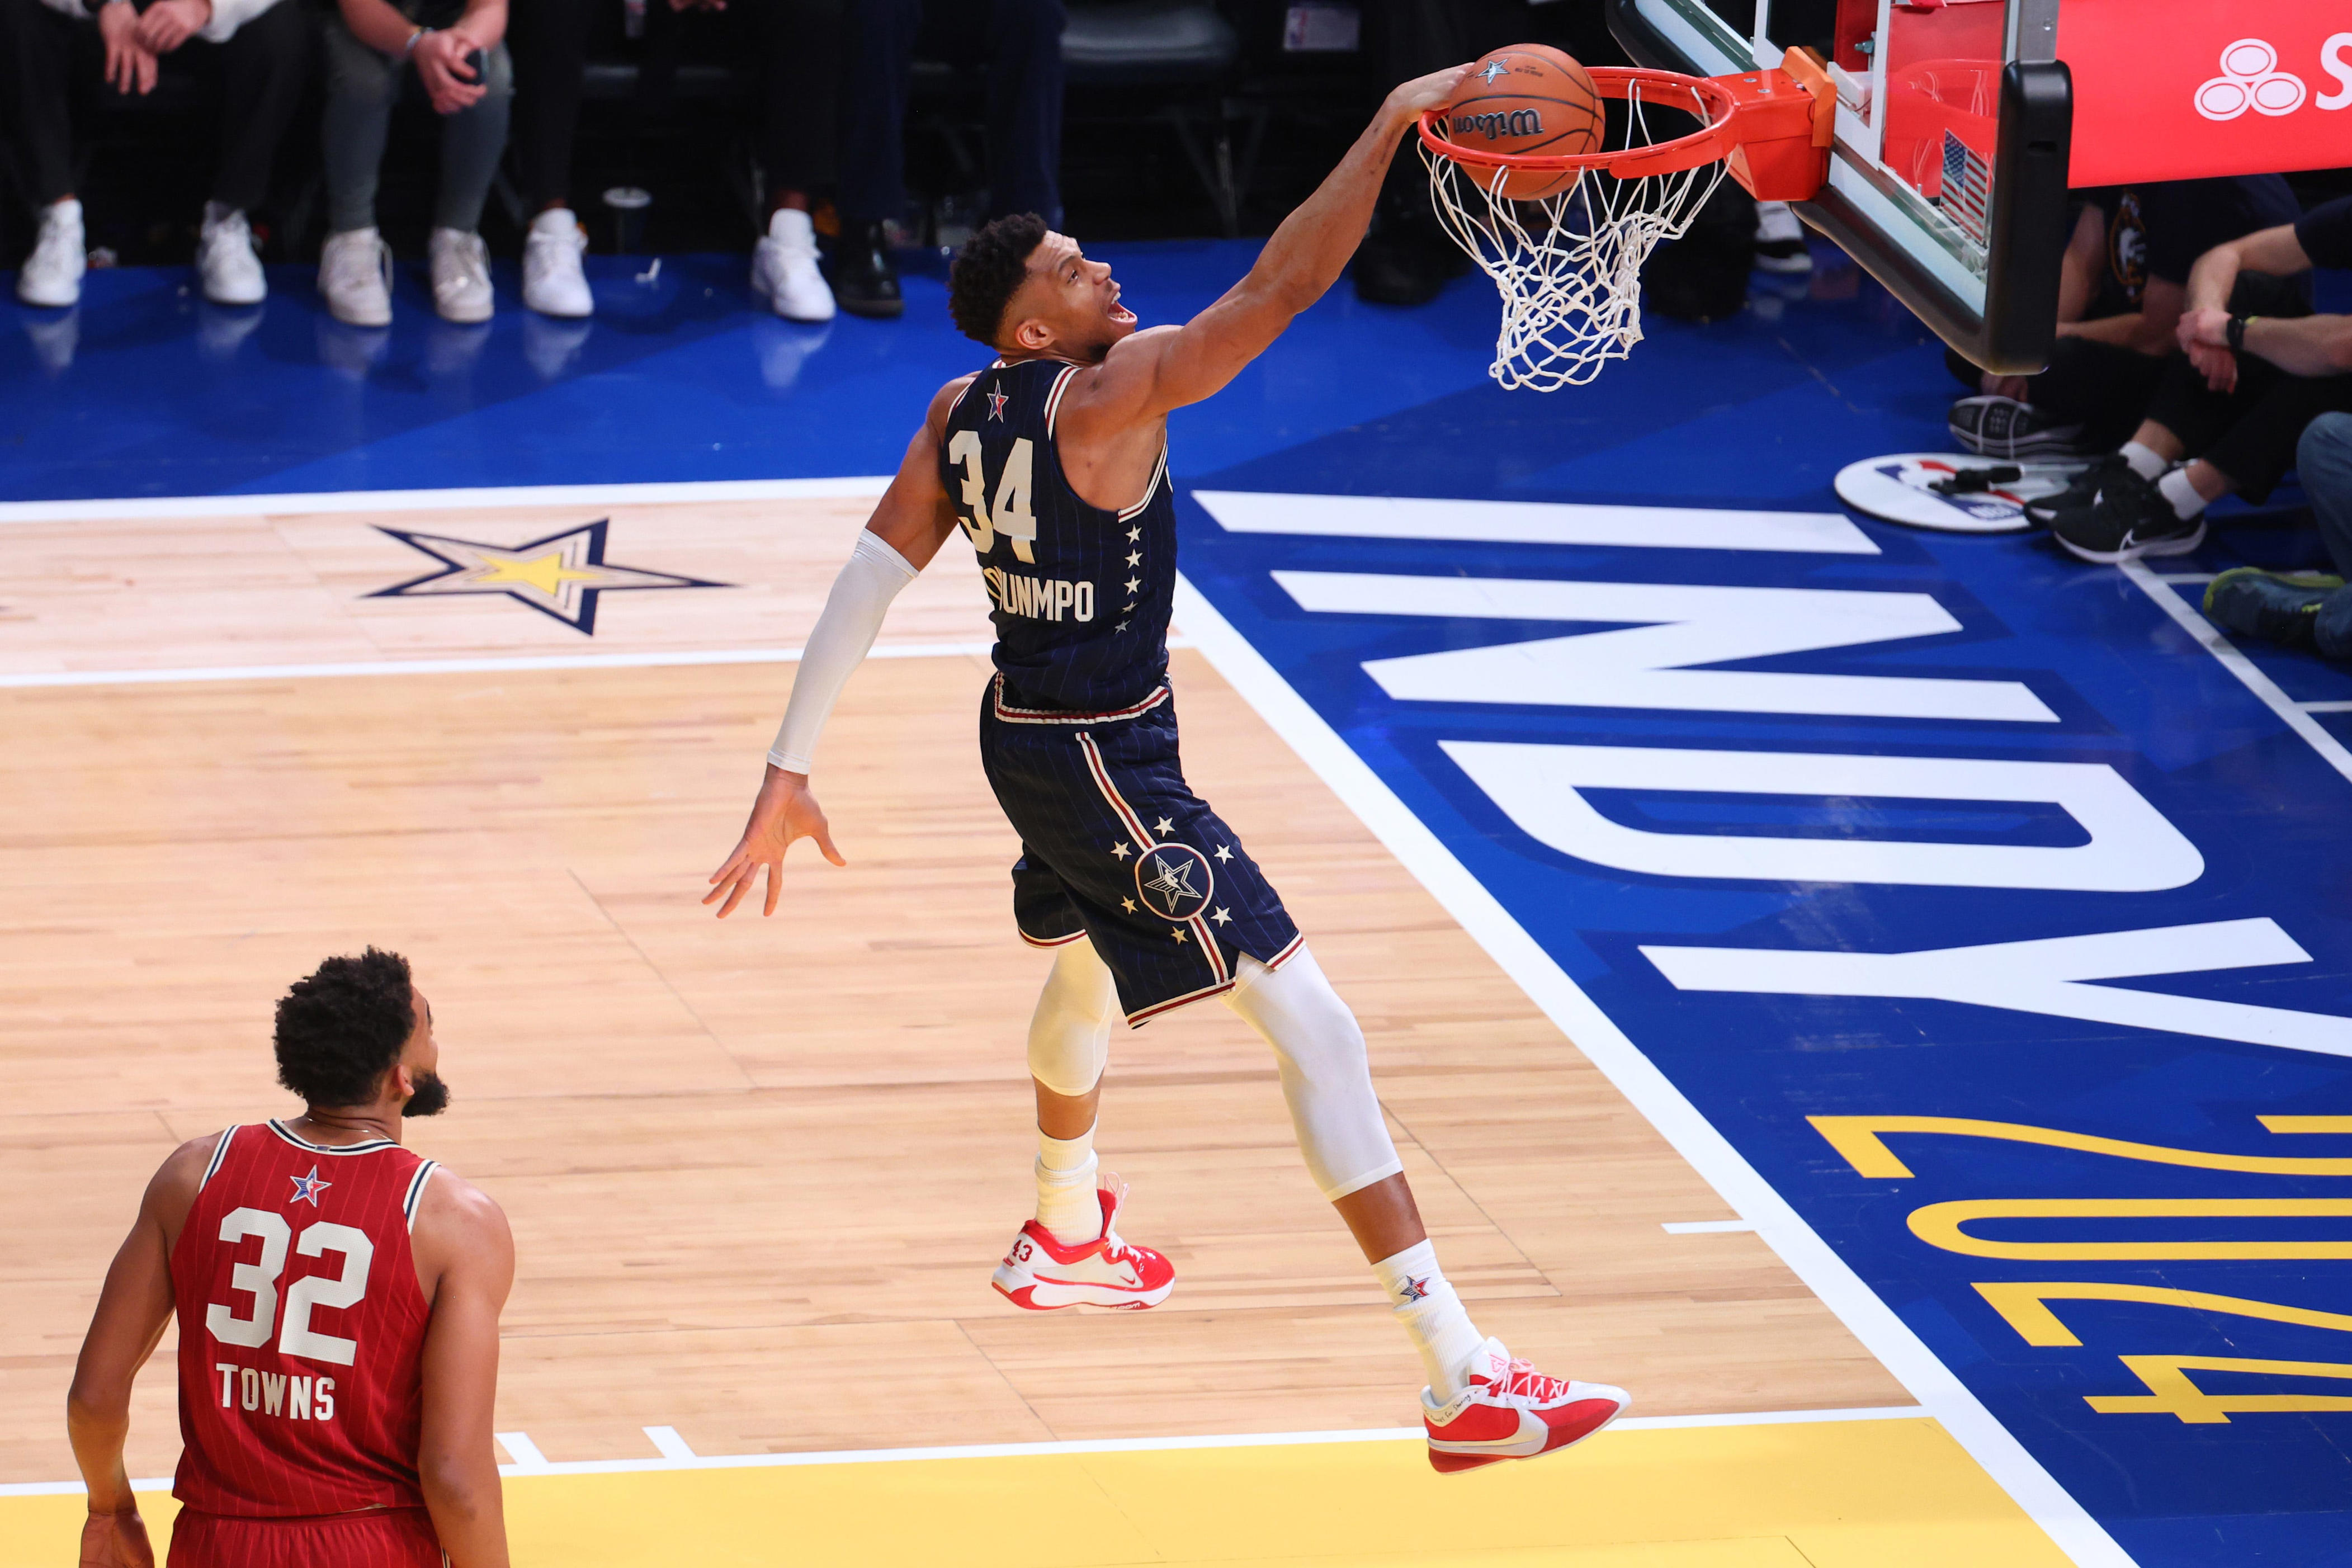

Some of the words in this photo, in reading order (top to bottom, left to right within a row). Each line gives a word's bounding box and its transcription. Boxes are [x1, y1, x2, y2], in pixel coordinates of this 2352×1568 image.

[1452, 108, 1545, 140] Wilson
[948, 430, 1037, 565] 34
[1192, 490, 2352, 1057] INDY
[205, 1207, 375, 1367] 32
[216, 1363, 336, 1421] TOWNS
